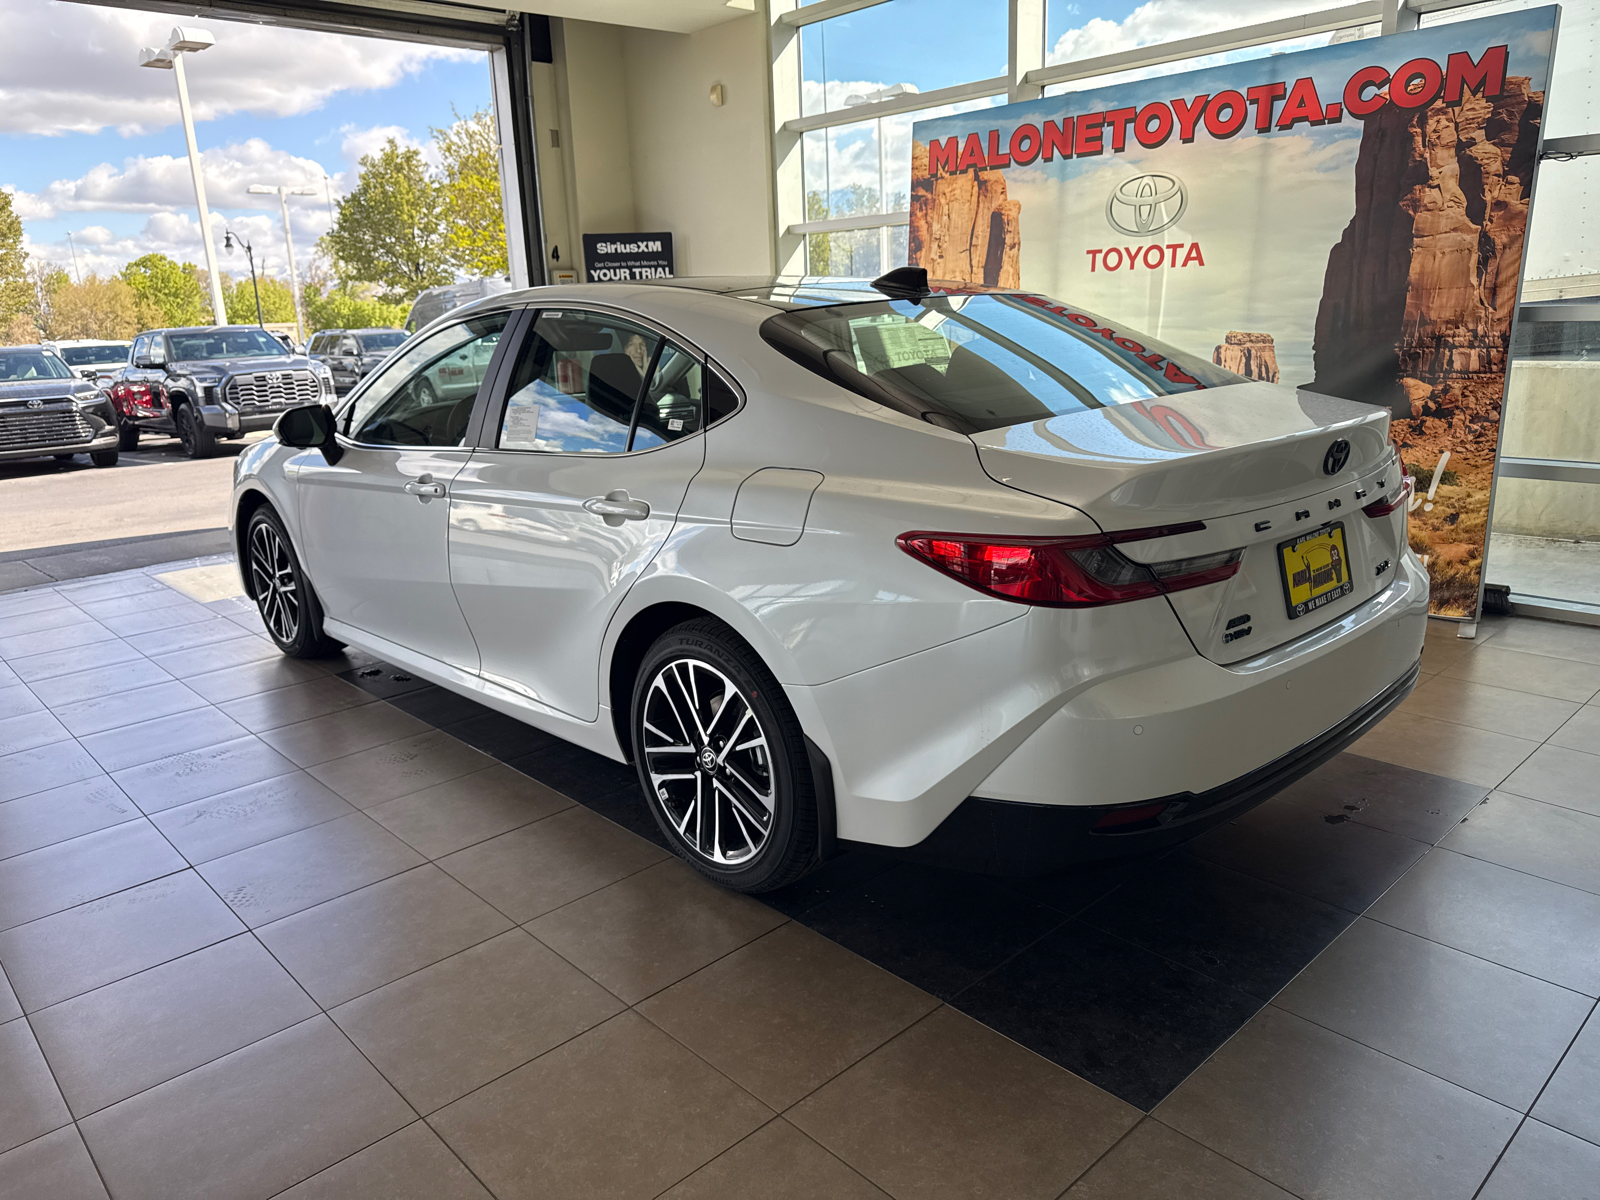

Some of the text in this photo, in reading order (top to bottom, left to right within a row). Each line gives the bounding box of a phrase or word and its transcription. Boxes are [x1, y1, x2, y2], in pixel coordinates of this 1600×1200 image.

[928, 43, 1509, 177] MALONETOYOTA.COM
[551, 245, 560, 262] 4
[596, 240, 662, 255] SiriusXM
[1086, 242, 1205, 272] TOYOTA
[590, 268, 630, 281] YOUR
[632, 266, 674, 280] TRIAL
[1254, 477, 1387, 532] CAMRY
[1332, 550, 1338, 560] 32
[1308, 600, 1315, 610] WE
[1316, 595, 1327, 606] MAKE
[1332, 588, 1341, 599] EASY
[677, 637, 743, 676] TURANZA
